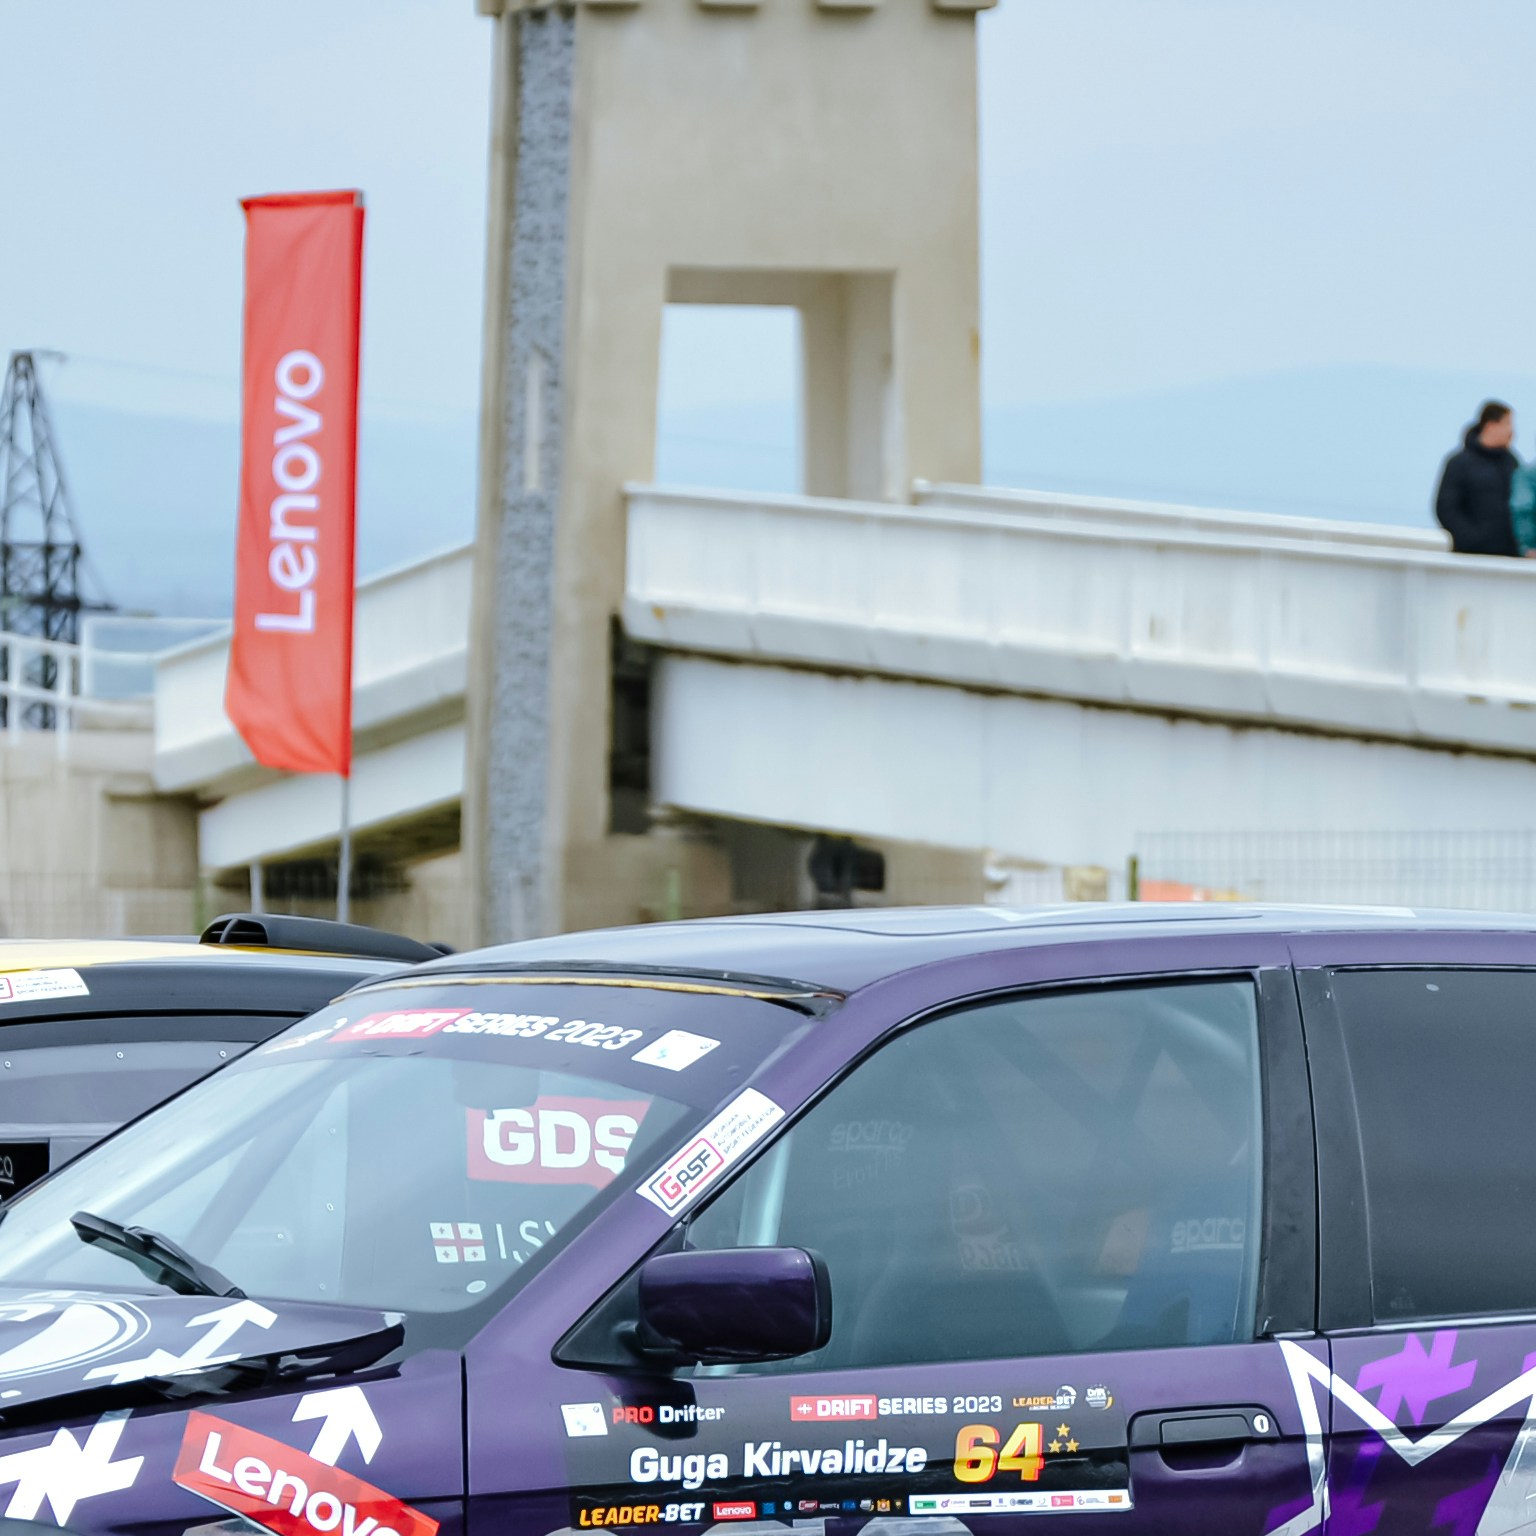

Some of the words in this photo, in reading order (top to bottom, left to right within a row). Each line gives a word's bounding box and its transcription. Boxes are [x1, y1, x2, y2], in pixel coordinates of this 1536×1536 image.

[254, 349, 324, 632] Lenovo
[444, 1012, 560, 1038] SERIES
[544, 1019, 643, 1050] 2023
[483, 1108, 639, 1175] GDS
[1170, 1217, 1246, 1252] sparc
[612, 1406, 655, 1425] PRO
[659, 1404, 726, 1424] Drifter
[817, 1398, 872, 1417] DRIFT
[878, 1396, 948, 1416] SERIES
[953, 1395, 1003, 1415] 2023
[629, 1446, 729, 1490] Guga
[743, 1438, 928, 1478] Kirvalidze
[953, 1422, 1045, 1483] 64
[579, 1502, 705, 1527] LEADER-BET
[716, 1504, 753, 1517] Lenovo
